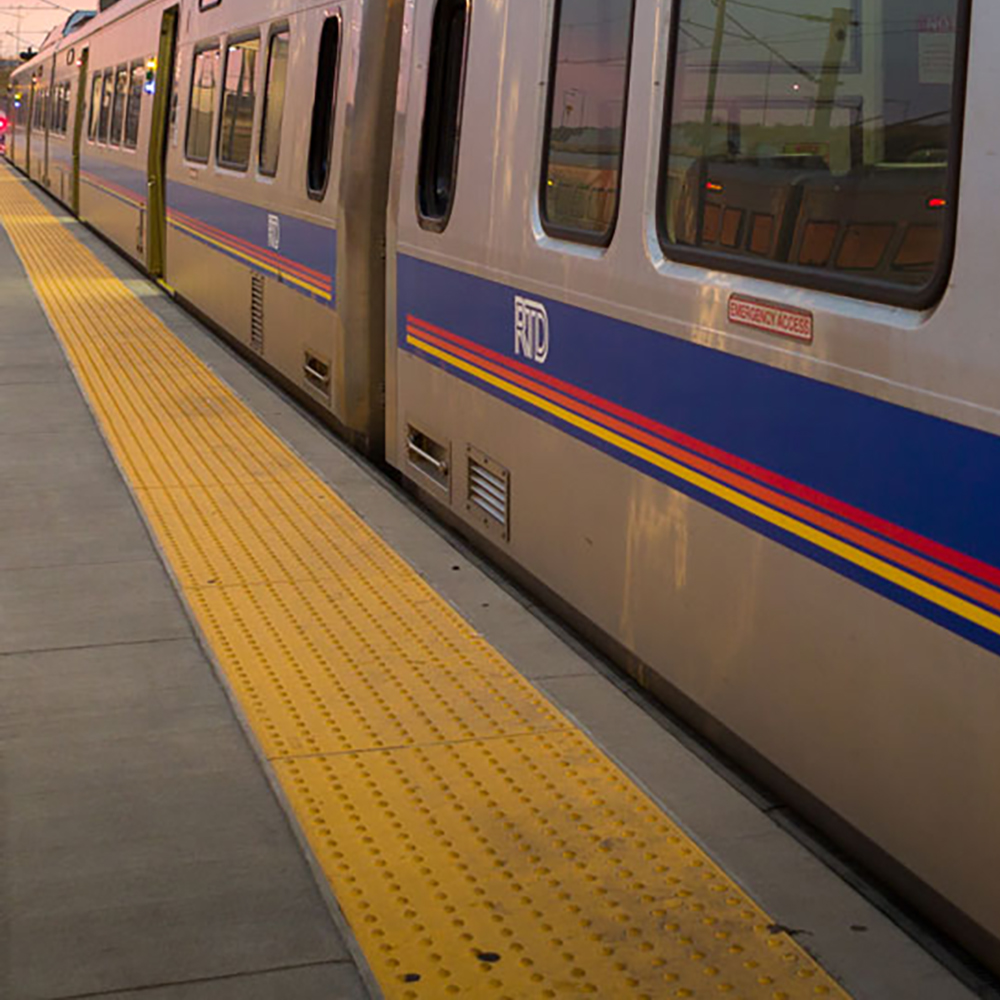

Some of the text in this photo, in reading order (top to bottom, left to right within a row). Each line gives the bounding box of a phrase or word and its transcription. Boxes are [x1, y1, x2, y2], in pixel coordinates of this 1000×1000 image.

[514, 296, 549, 363] RTD
[729, 302, 811, 335] EMERGENCY ACCESS
